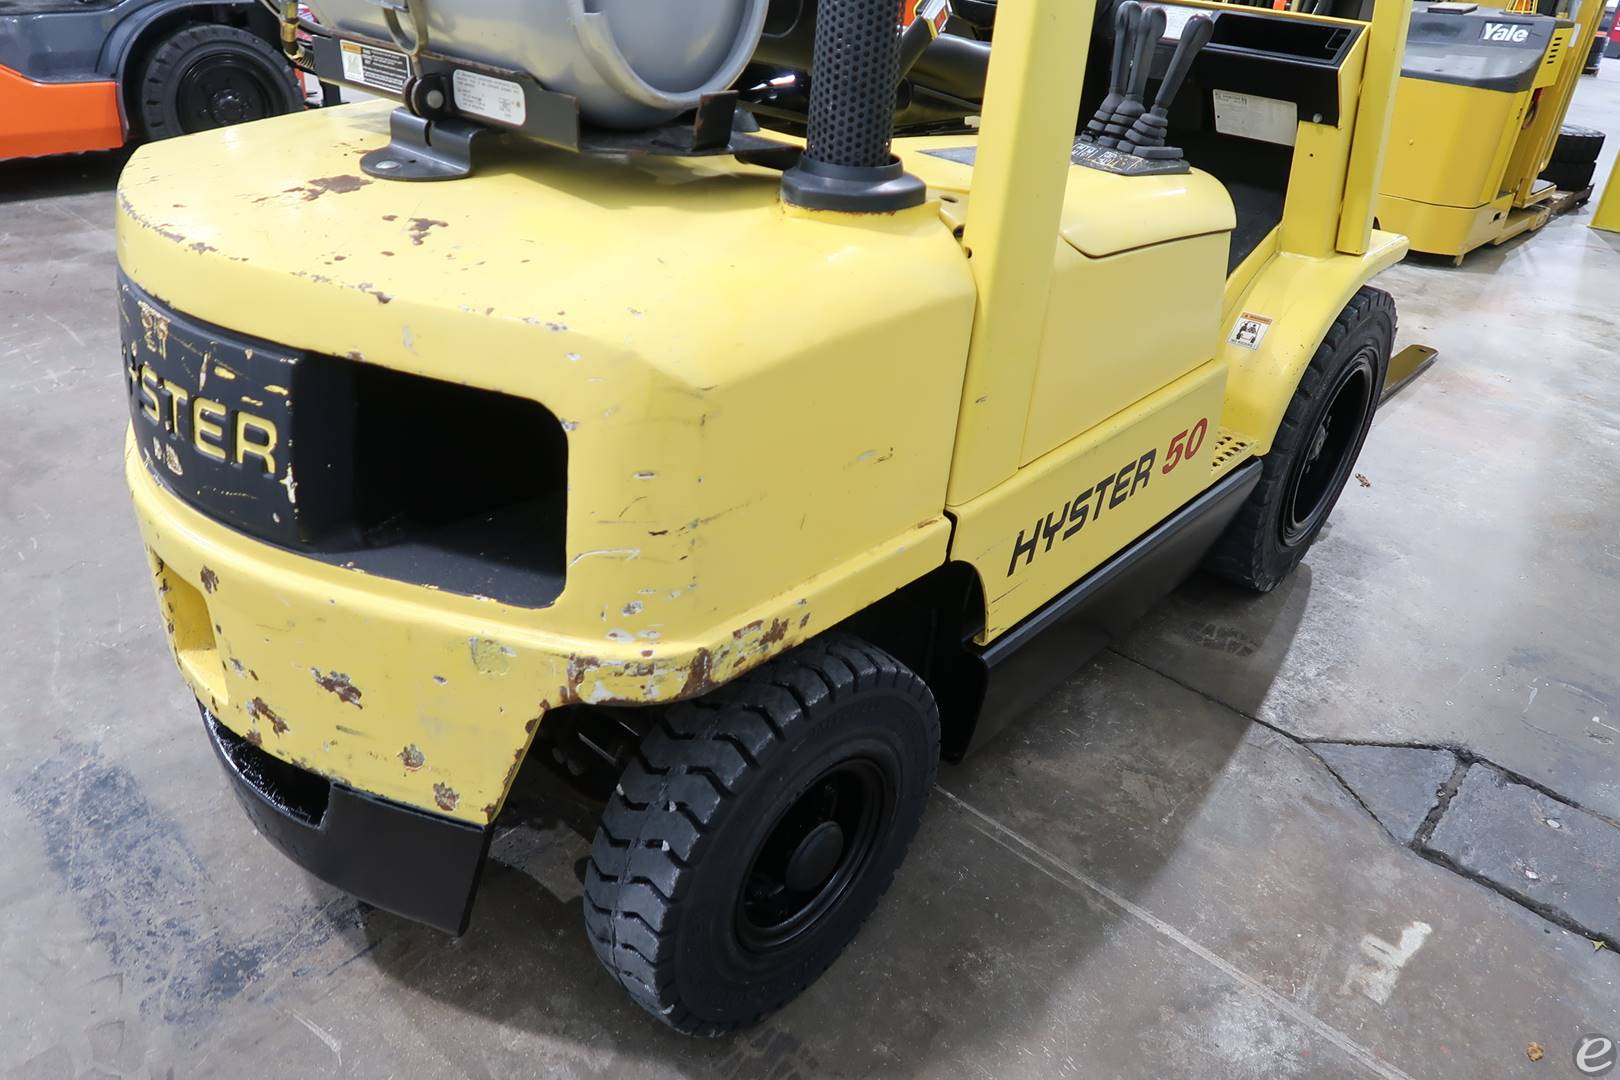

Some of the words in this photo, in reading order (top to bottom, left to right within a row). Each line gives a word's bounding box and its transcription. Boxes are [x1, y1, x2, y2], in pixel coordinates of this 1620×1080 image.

[1483, 22, 1529, 43] Yale
[1006, 448, 1157, 578] HYSTER
[1162, 417, 1208, 475] 50
